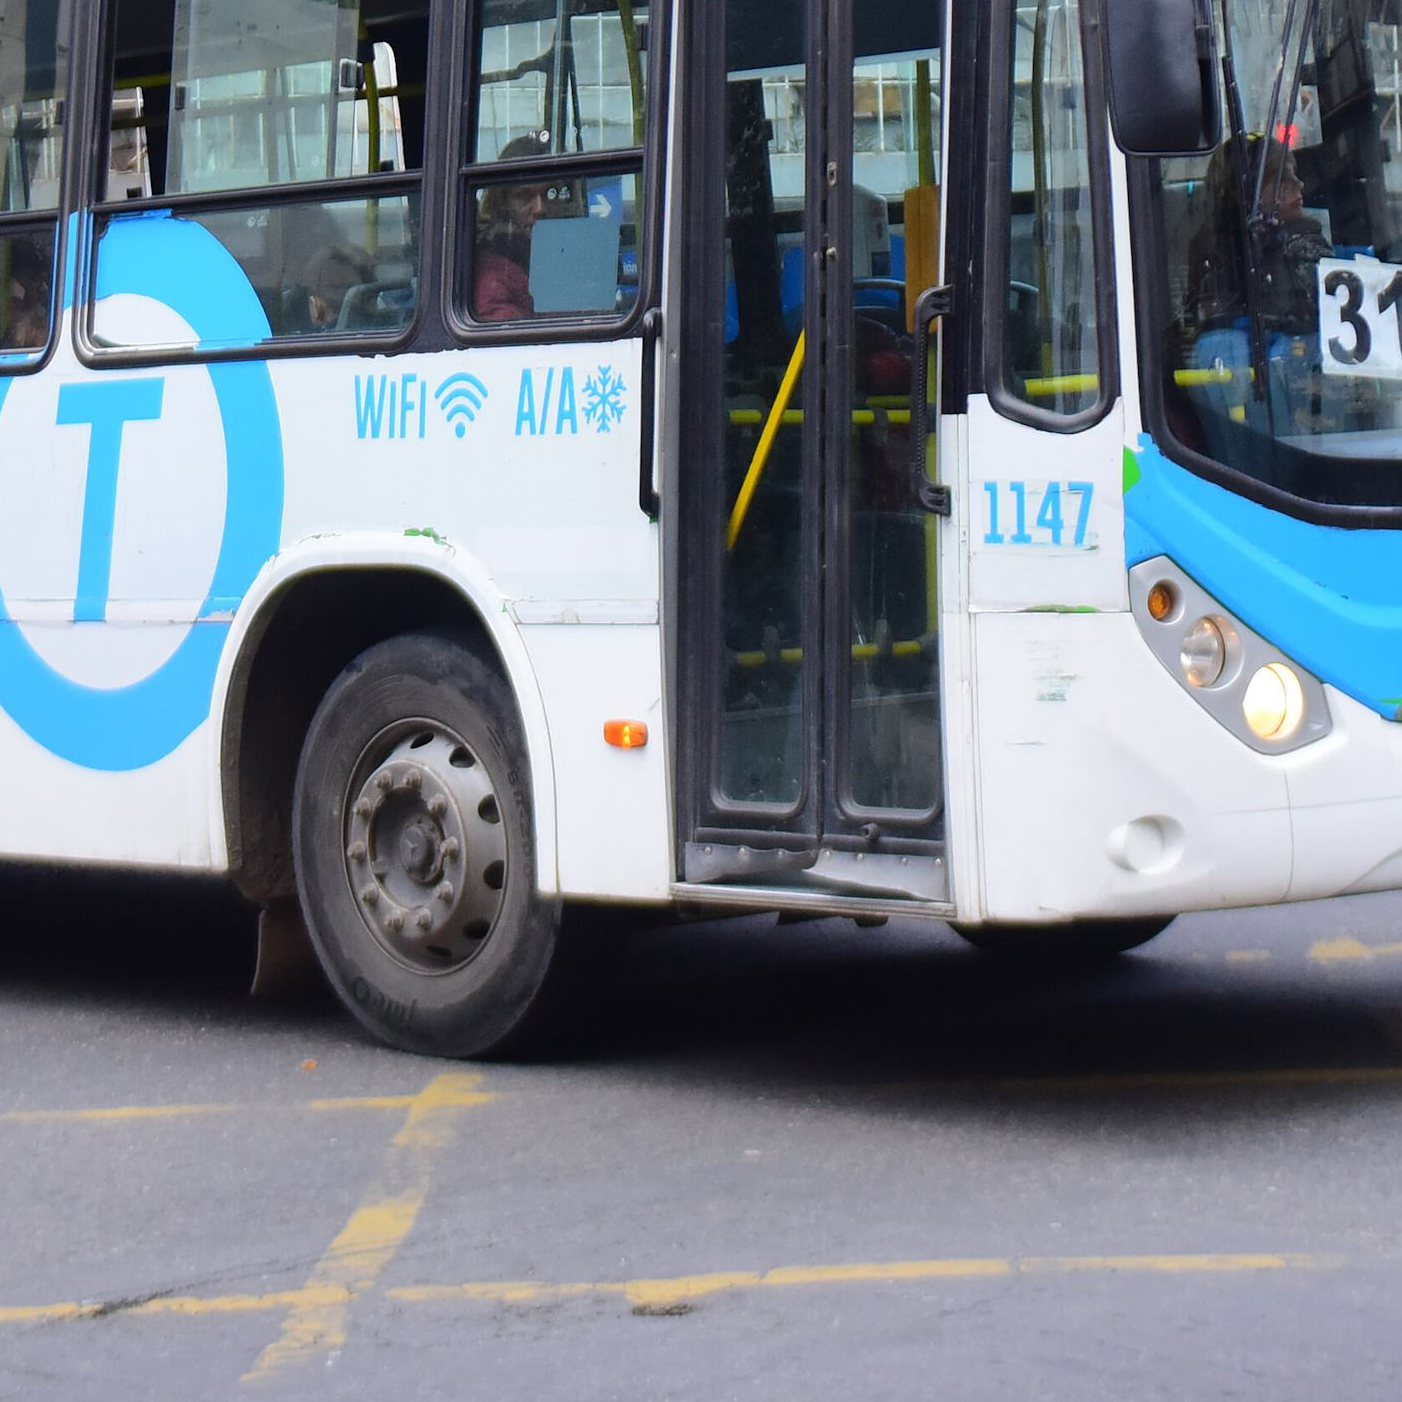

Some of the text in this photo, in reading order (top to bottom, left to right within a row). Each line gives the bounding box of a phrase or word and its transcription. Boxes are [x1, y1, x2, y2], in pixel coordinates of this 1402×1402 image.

[515, 366, 579, 436] A/A
[55, 376, 166, 623] T
[983, 480, 1095, 546] 1147
